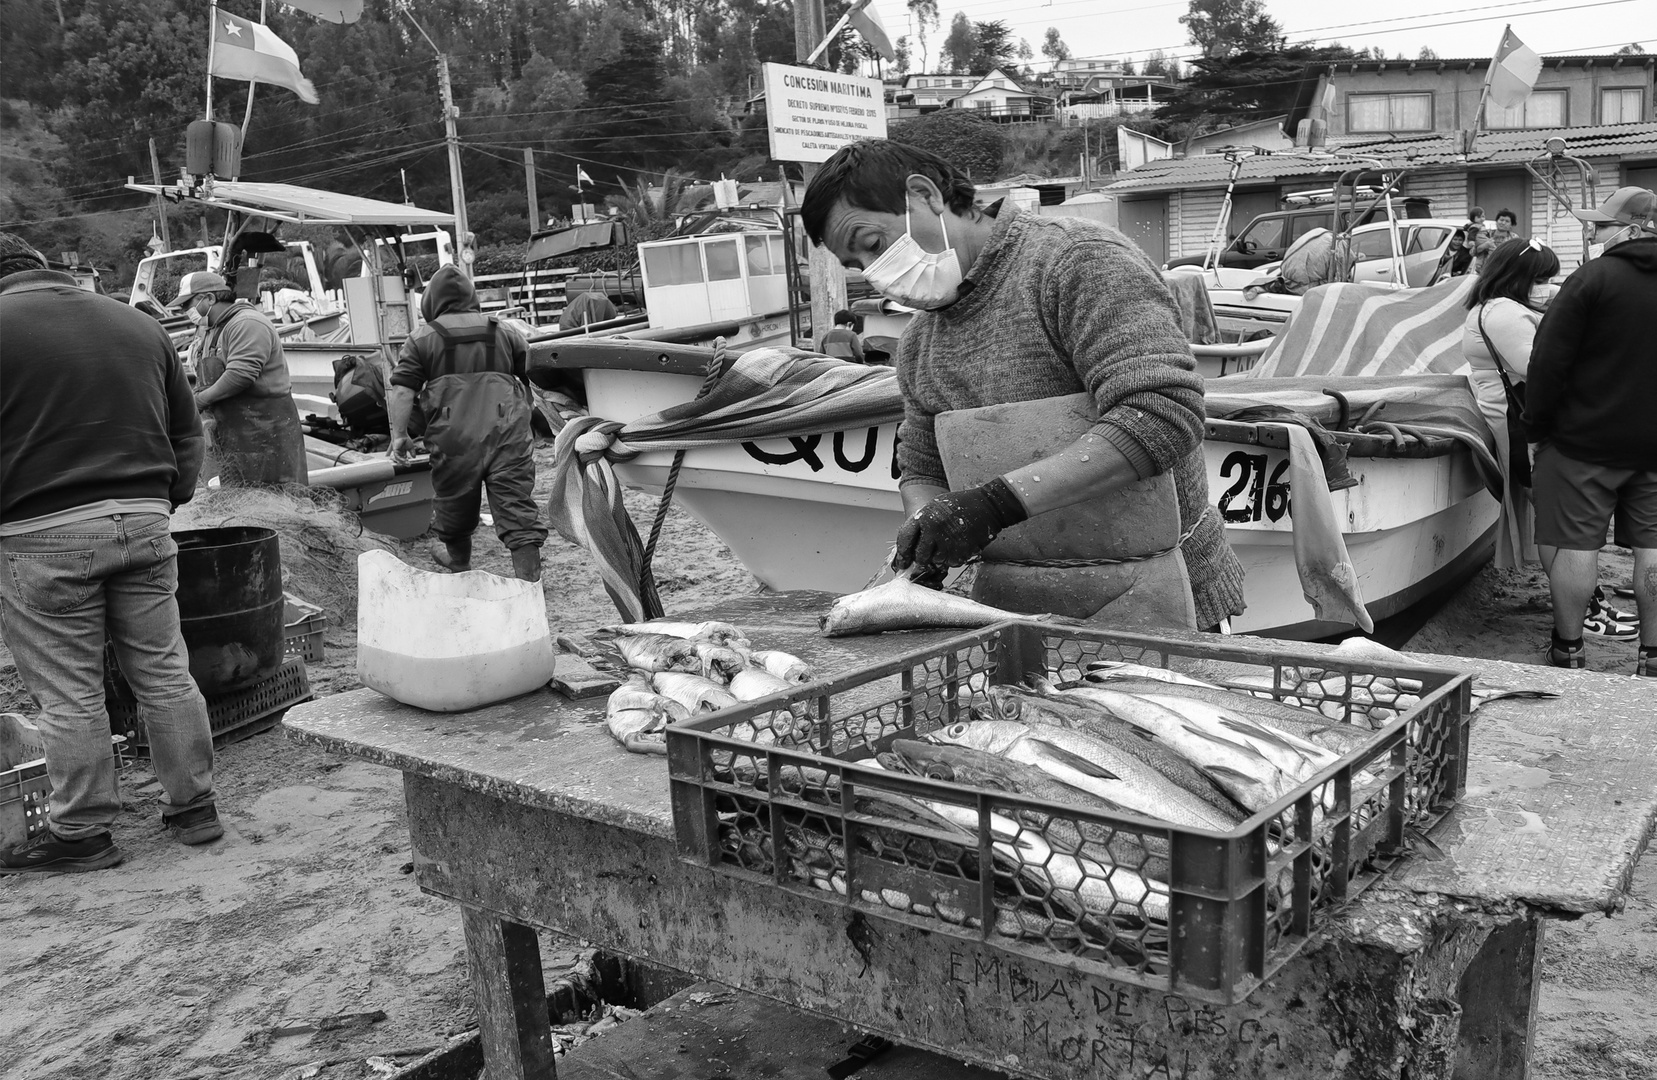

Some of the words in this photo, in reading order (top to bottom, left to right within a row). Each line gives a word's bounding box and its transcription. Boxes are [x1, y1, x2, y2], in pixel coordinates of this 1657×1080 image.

[784, 75, 828, 92] CONCESIÓN
[787, 99, 808, 109] DECRETO
[809, 101, 830, 112] SUPREMO
[849, 106, 865, 116] FEBRERO
[792, 115, 806, 123] SECTOR
[774, 126, 794, 135] SINDICATO
[801, 129, 824, 138] PESCADORES
[1218, 451, 1292, 523] 216
[1092, 985, 1133, 1017] DE
